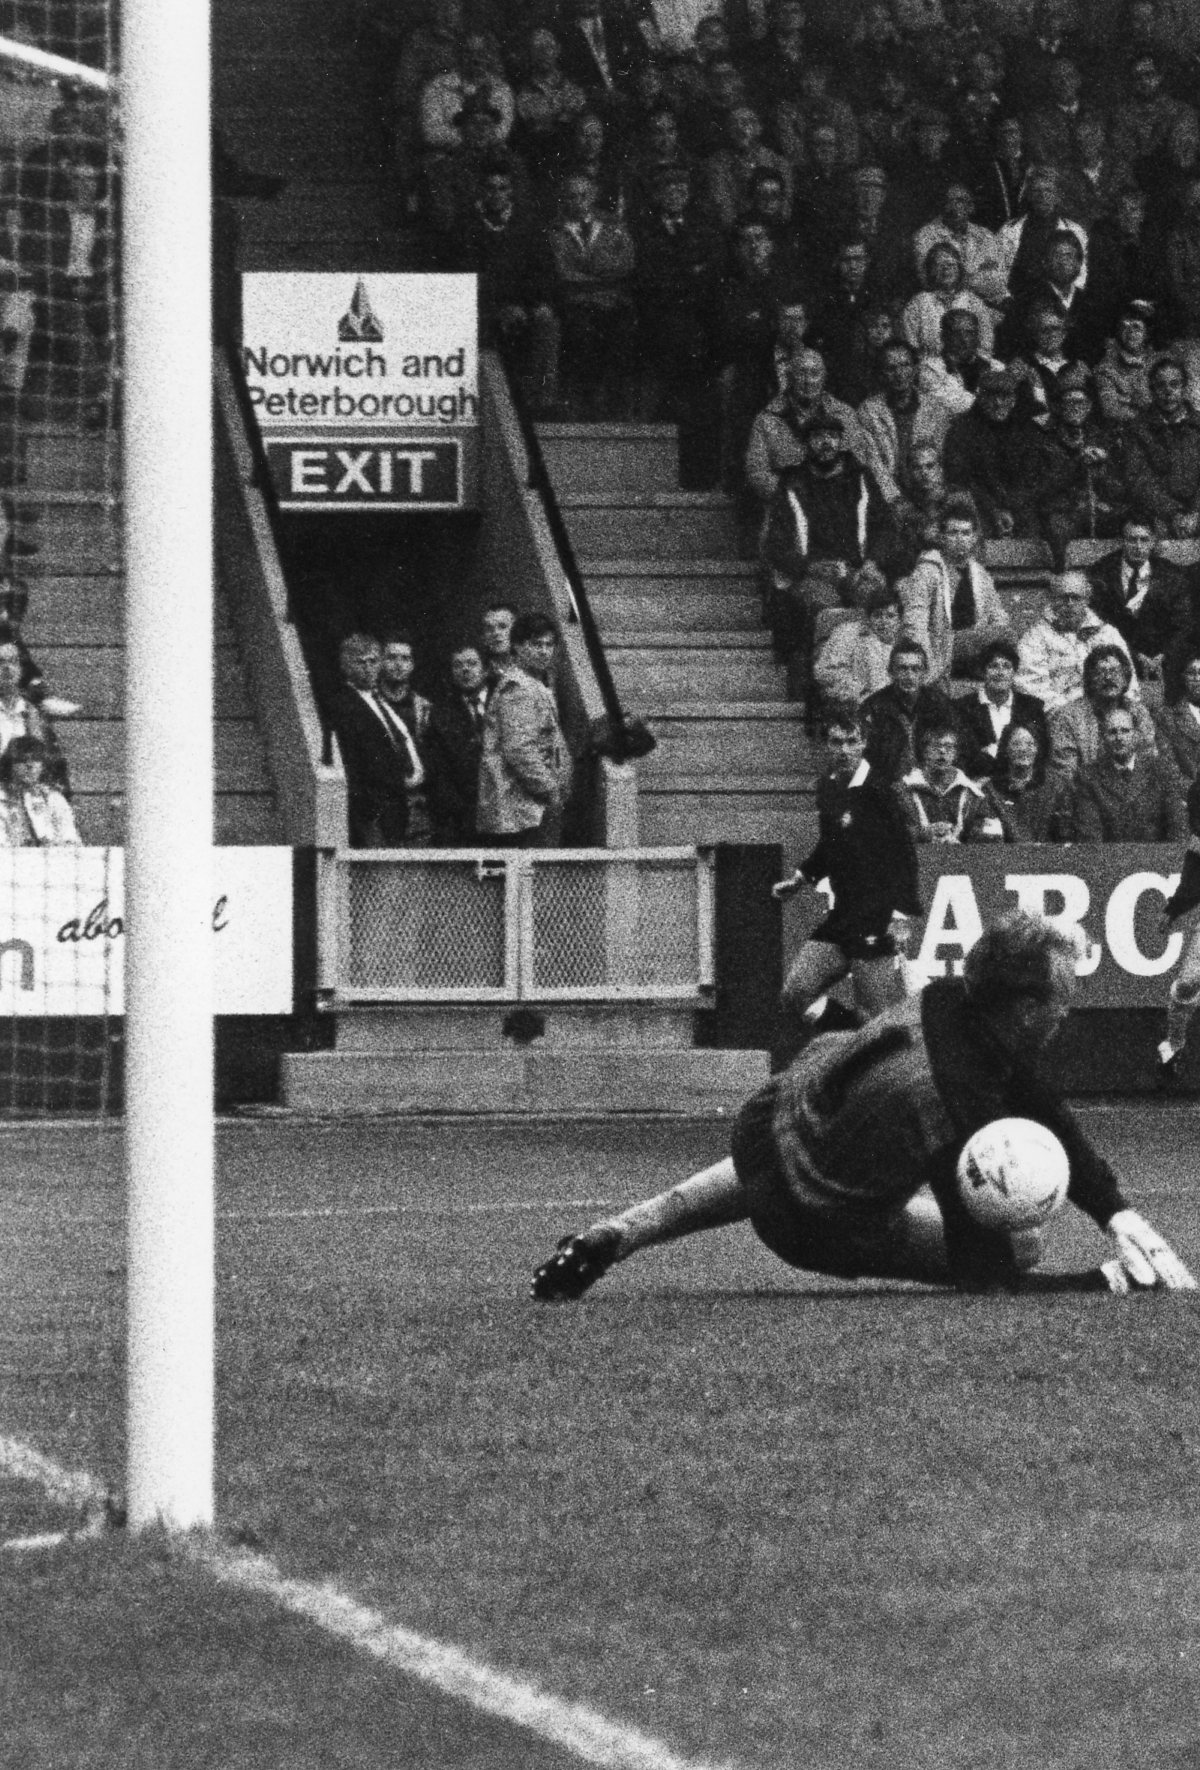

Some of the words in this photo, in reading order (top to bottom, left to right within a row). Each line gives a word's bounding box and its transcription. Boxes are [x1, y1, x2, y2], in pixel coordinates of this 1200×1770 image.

[244, 346, 386, 377] Norwich
[402, 348, 464, 377] and
[248, 386, 478, 424] Peterborough
[291, 450, 437, 493] EXIT
